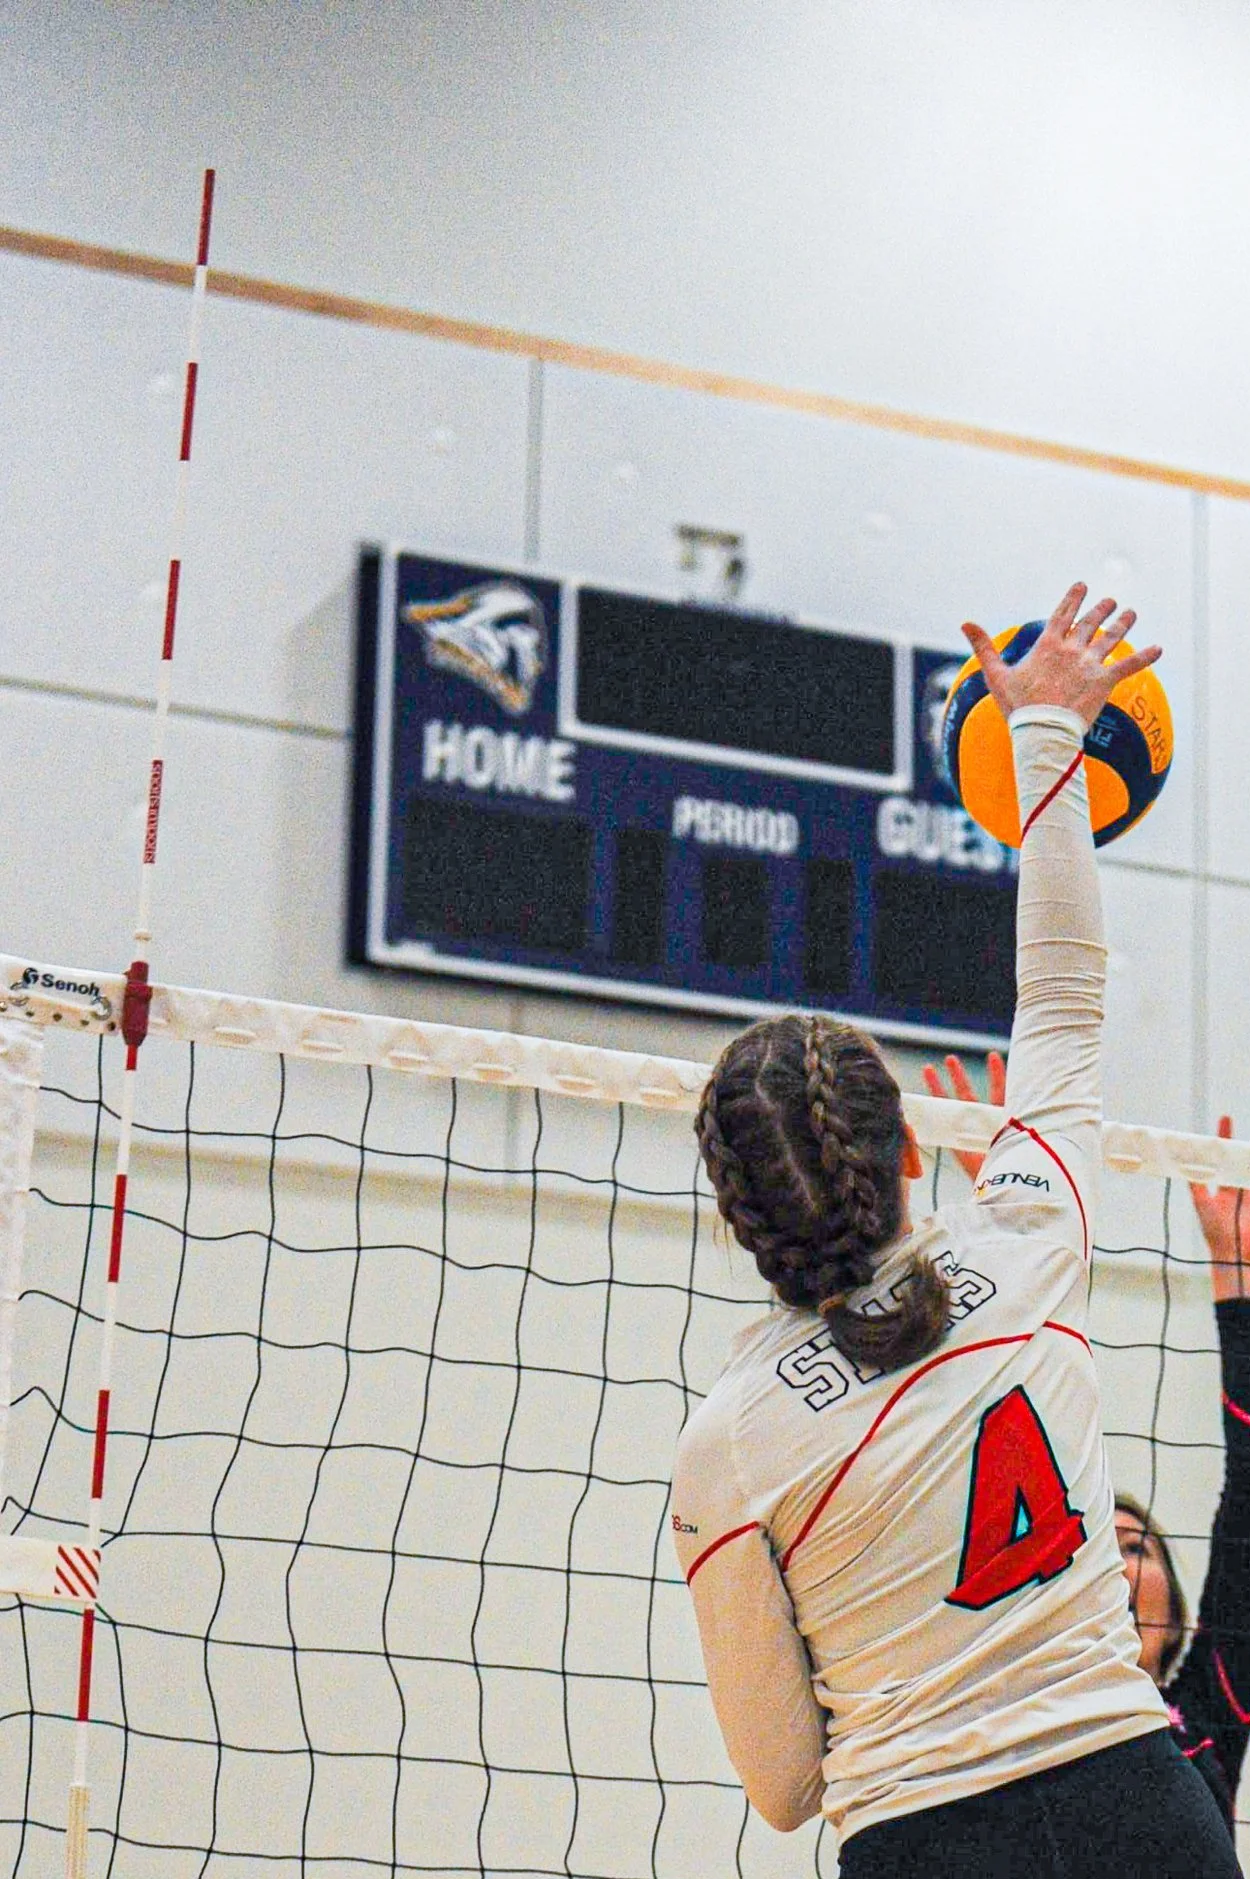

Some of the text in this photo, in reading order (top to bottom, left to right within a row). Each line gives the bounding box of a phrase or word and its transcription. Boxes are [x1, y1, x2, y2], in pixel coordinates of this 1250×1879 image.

[422, 720, 577, 802] HOME
[671, 795, 799, 855] PERIOD
[41, 974, 100, 997] Senoh
